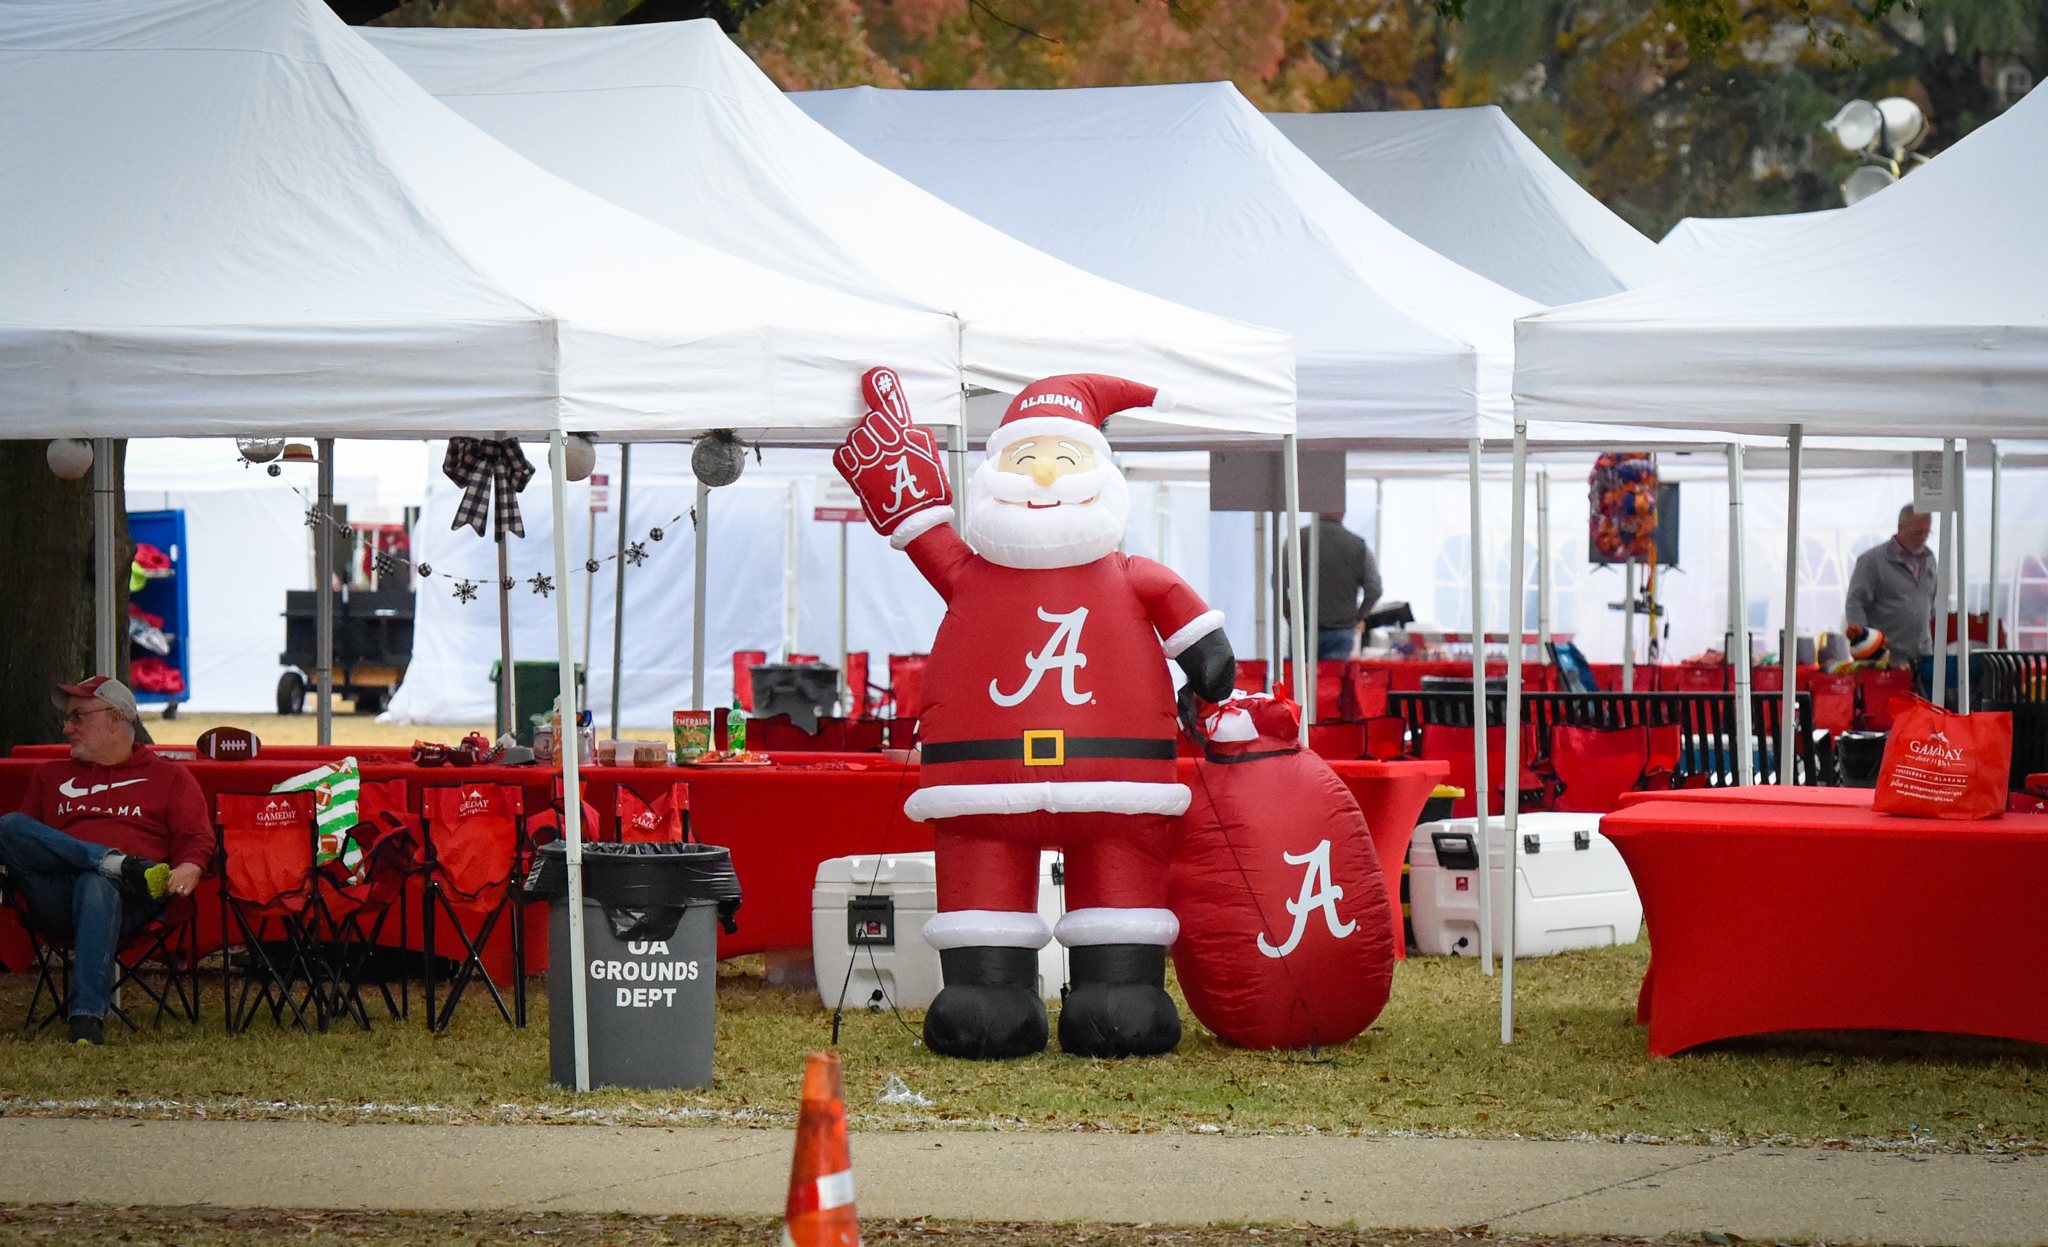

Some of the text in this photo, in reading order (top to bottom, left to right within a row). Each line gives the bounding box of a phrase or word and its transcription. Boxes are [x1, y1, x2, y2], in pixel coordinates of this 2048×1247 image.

[1019, 393, 1085, 416] ALABAMA
[882, 455, 926, 514] A
[989, 605, 1093, 707] A
[256, 811, 297, 821] GAMEDAY
[1256, 839, 1357, 959] A
[627, 940, 670, 955] UA
[590, 959, 699, 982] GROUNDS
[616, 987, 677, 1008] DEPT
